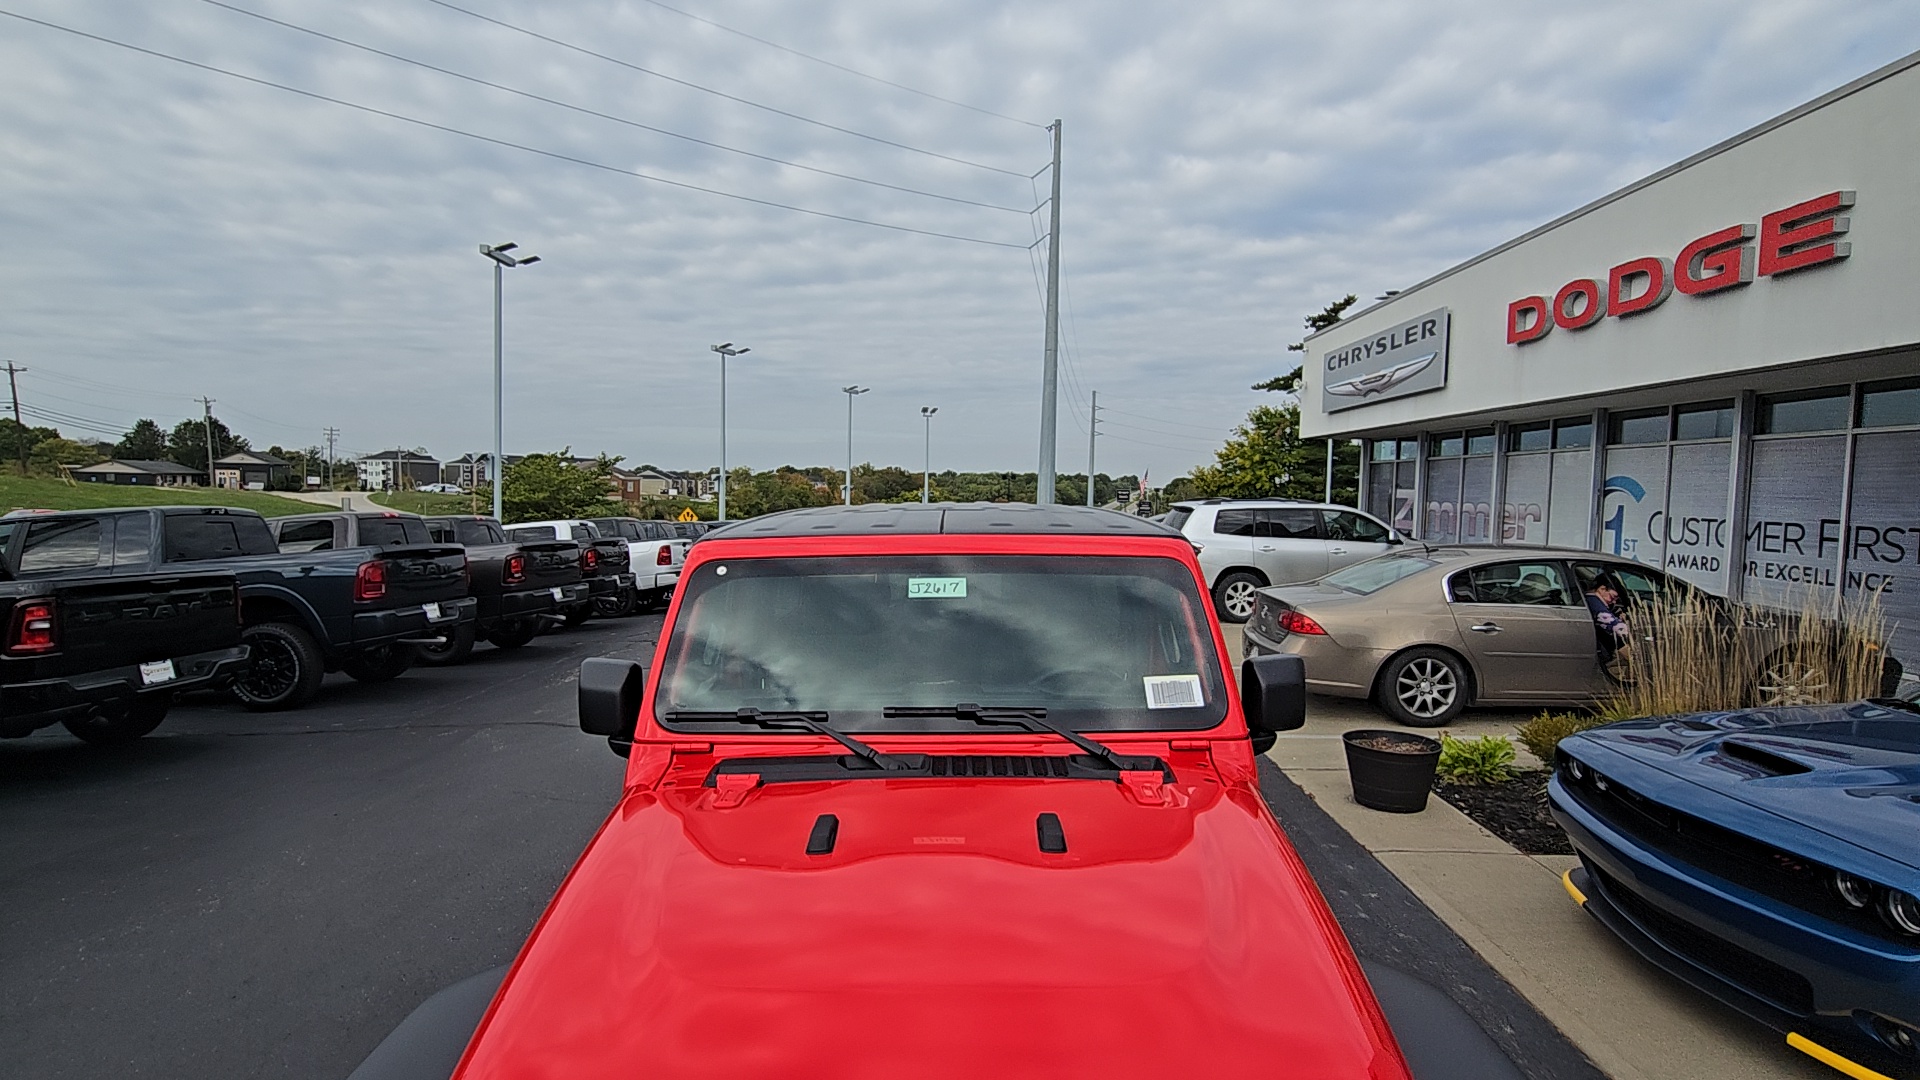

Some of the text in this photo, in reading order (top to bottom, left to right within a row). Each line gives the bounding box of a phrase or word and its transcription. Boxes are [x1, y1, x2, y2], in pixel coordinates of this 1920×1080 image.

[1506, 190, 1856, 345] DODGE
[1327, 319, 1437, 371] CHRYSLER
[1395, 488, 1541, 541] Zmmer
[1817, 518, 1920, 565] FIRST
[909, 582, 960, 594] J2617
[1667, 553, 1720, 572] AWARD
[1764, 560, 1896, 593] EXCELLNCE
